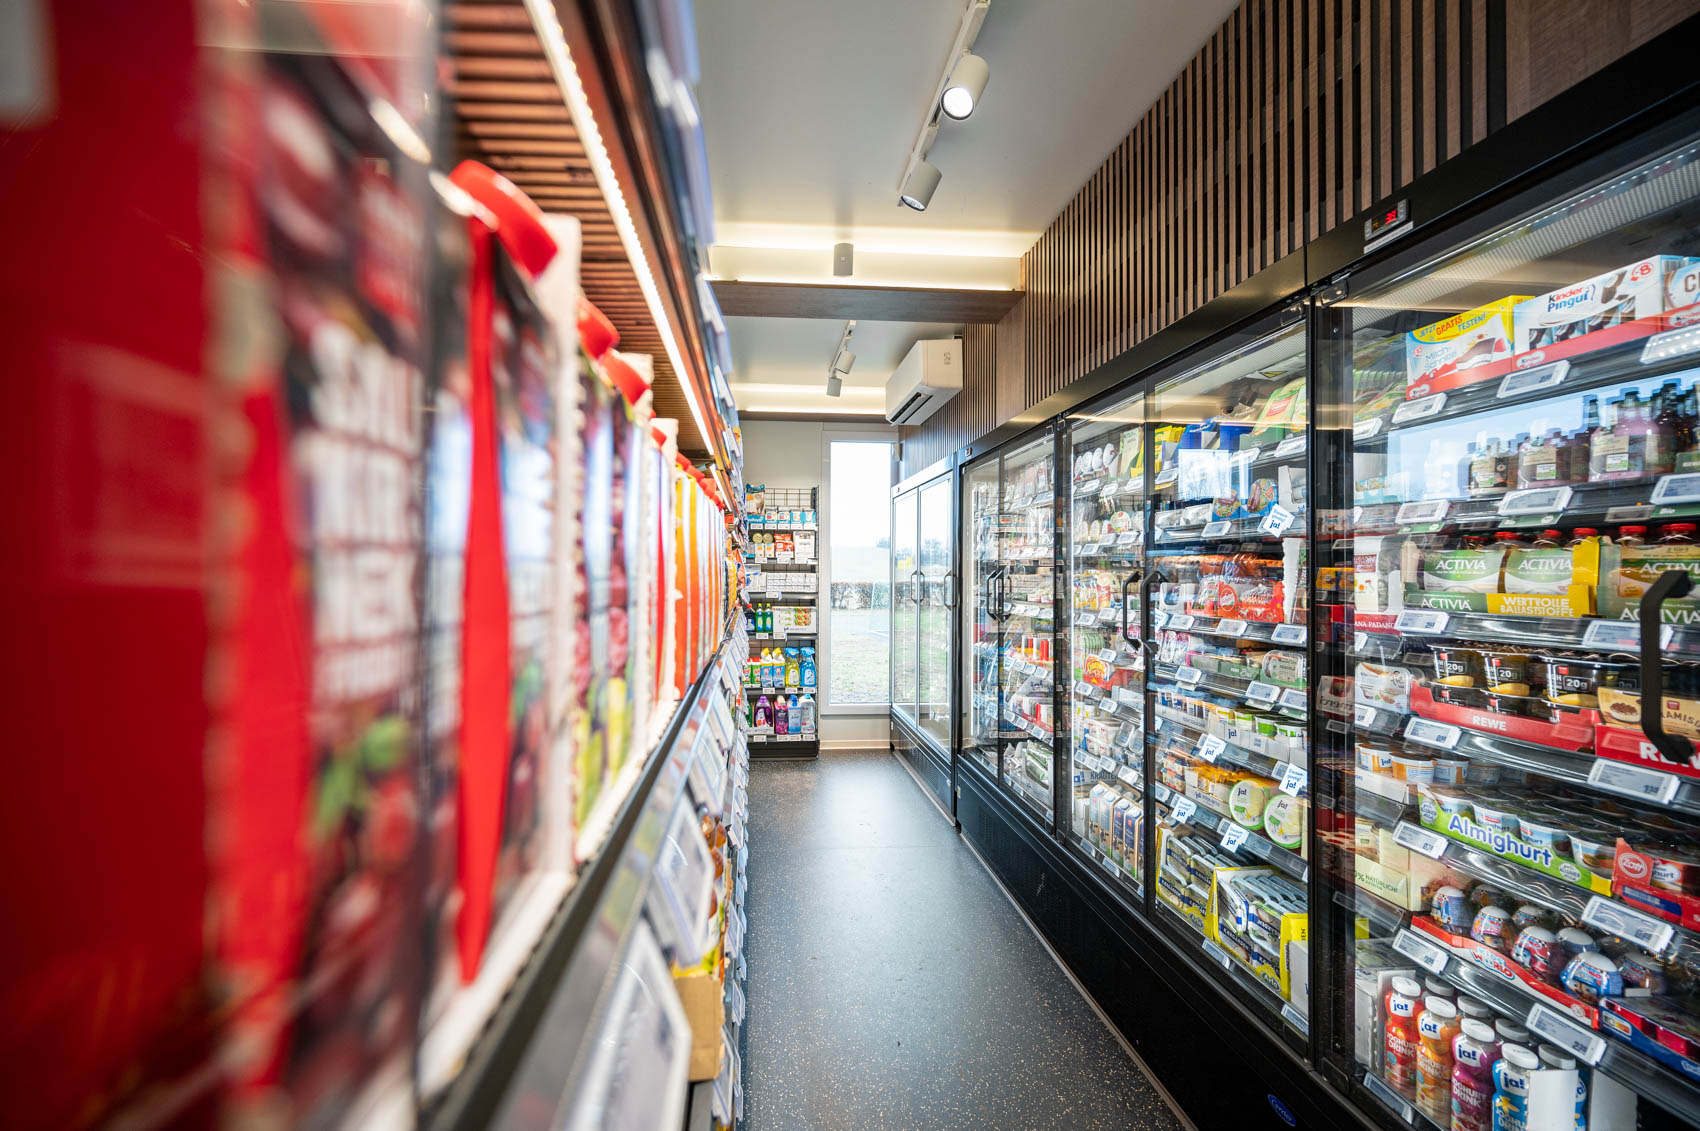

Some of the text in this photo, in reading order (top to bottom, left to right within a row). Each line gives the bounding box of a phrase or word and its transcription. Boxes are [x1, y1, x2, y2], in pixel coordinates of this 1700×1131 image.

[1548, 286, 1584, 303] Kinder
[1420, 311, 1486, 338] JETZT GRATIS TESTEN!
[1270, 520, 1280, 529] ja!
[1435, 559, 1487, 570] ACTIVIA
[1518, 558, 1573, 570] ACTIVIA
[1421, 598, 1472, 611] ACTIVIA
[1503, 596, 1569, 608] WERTVOLLE
[1500, 605, 1574, 617] BALLASTSTOFFE
[1447, 663, 1464, 673] 20g
[1499, 670, 1518, 680] 20g
[1566, 678, 1588, 689] 20g
[1472, 716, 1507, 731] REWE
[1228, 728, 1237, 739] ja!
[1205, 747, 1215, 756] ja!
[1286, 780, 1297, 789] ja!
[1238, 787, 1247, 797] ja!
[1277, 800, 1288, 810] ja!
[1176, 809, 1186, 817] ja!
[1226, 837, 1237, 846] ja!
[1449, 815, 1551, 866] Almighurt
[1263, 973, 1279, 989] Arla
[1393, 999, 1408, 1011] ja!
[1421, 1018, 1437, 1033] ja!
[1388, 1038, 1415, 1057] DRINK
[1458, 1044, 1477, 1060] ja!
[1503, 1072, 1525, 1090] ja!
[1453, 1084, 1481, 1108] DRINK
[1271, 1099, 1292, 1122] Carrier
